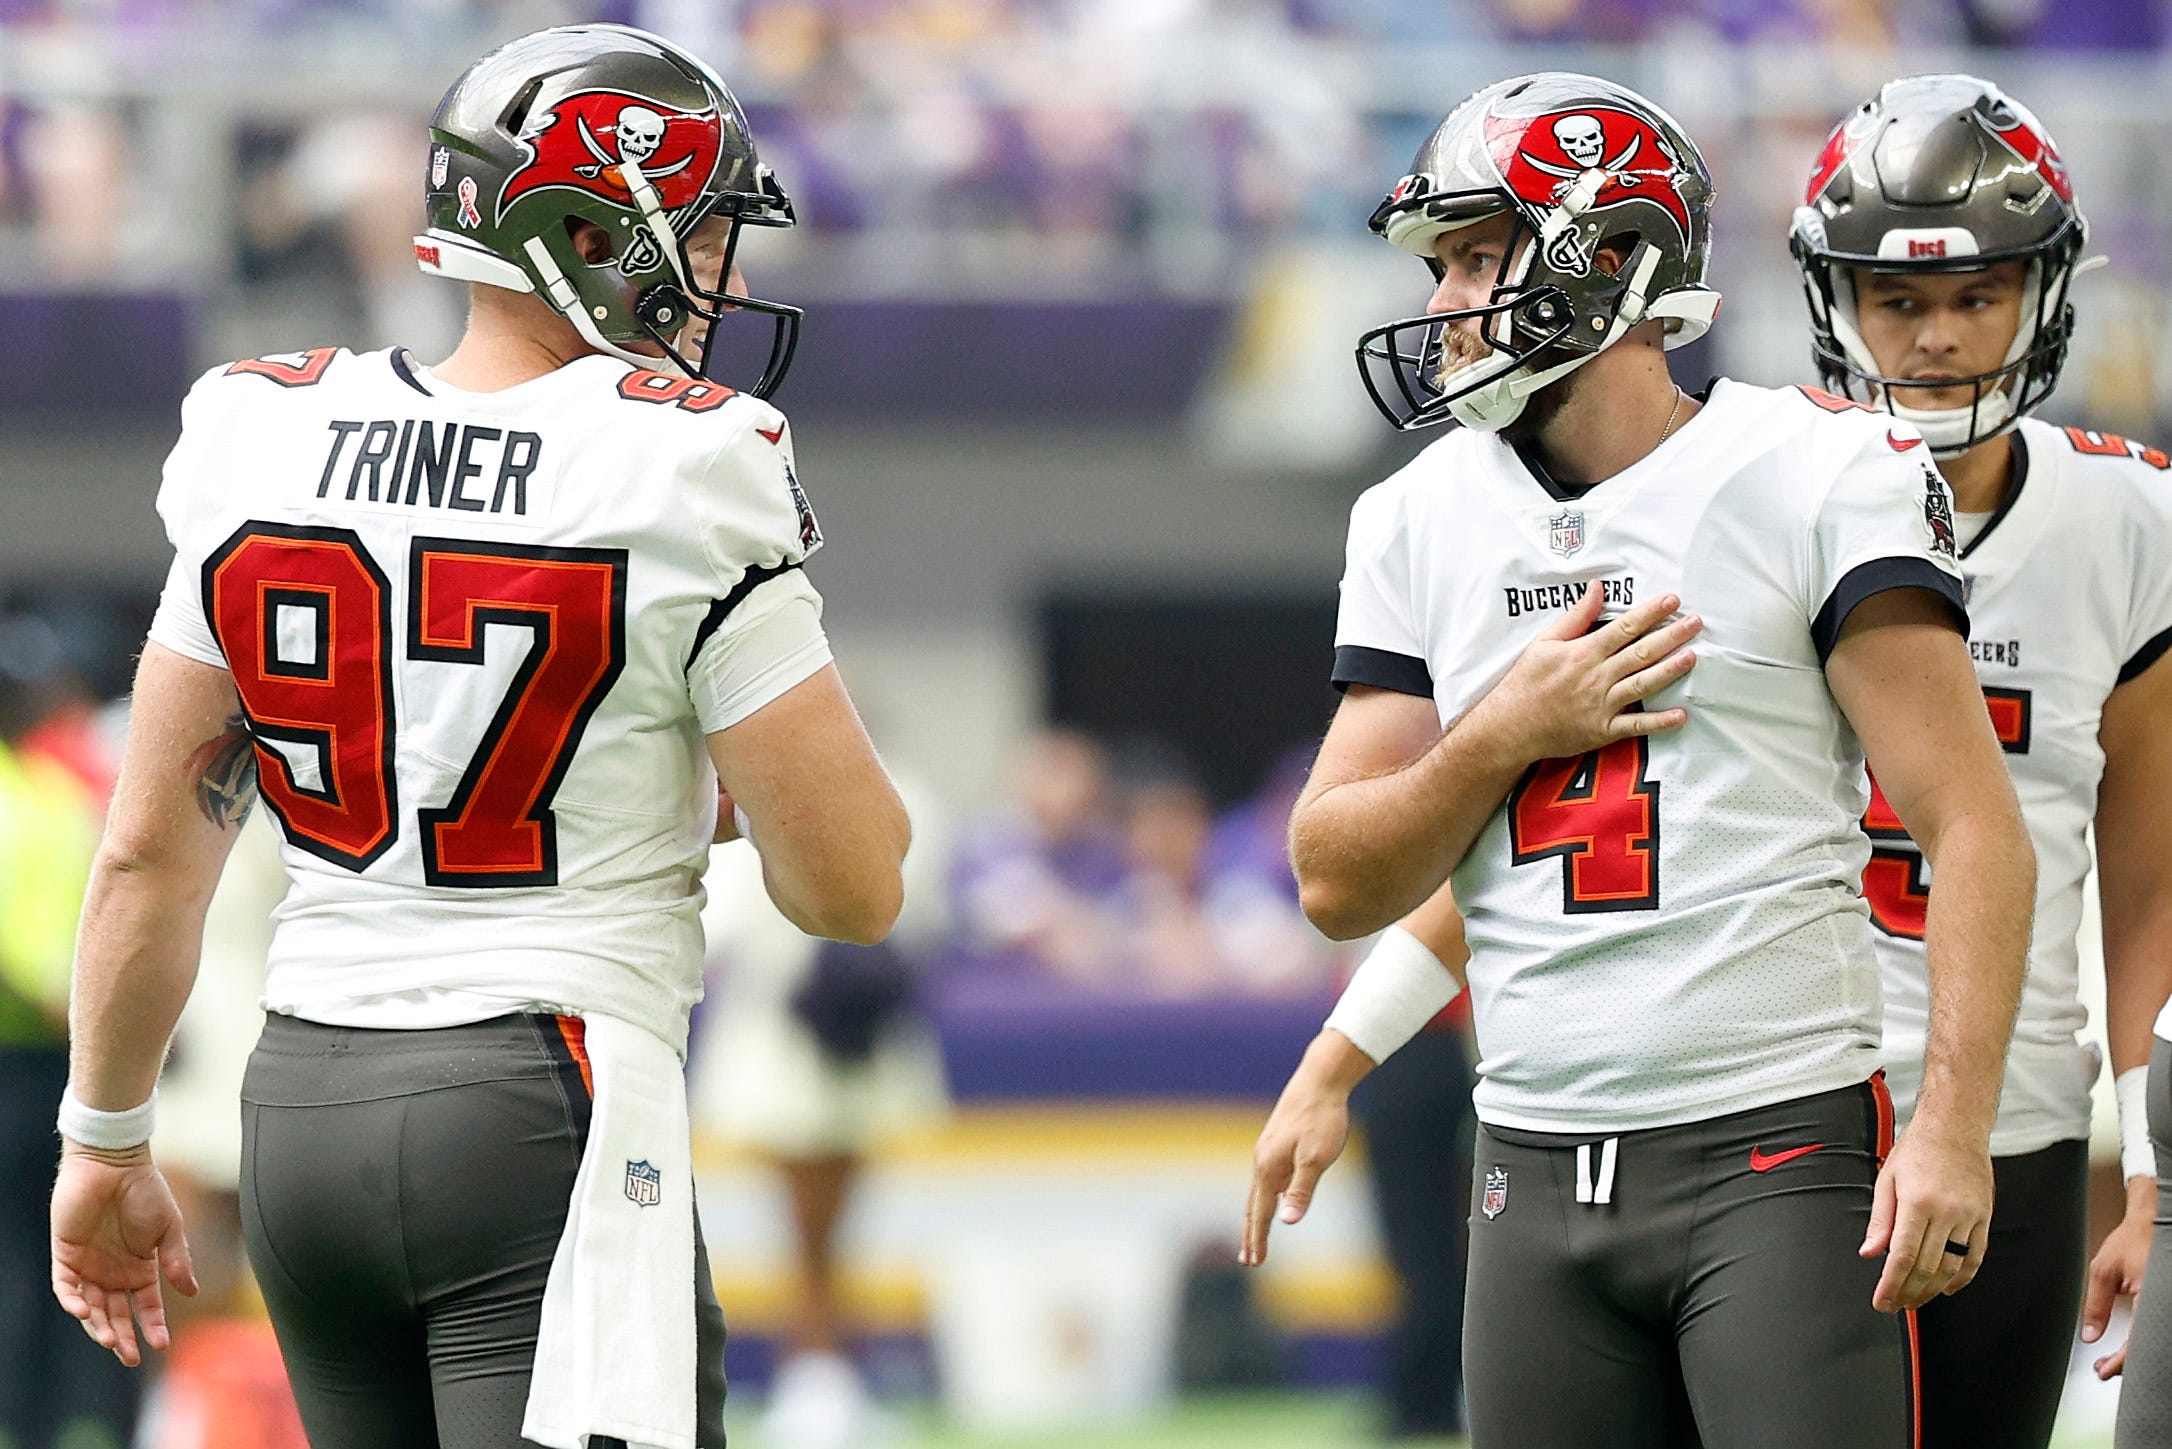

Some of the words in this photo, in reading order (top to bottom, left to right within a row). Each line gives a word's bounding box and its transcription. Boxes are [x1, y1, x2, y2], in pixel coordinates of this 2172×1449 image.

[316, 419, 543, 516] TRINER
[1554, 530, 1580, 549] NFL
[1504, 577, 1634, 617] BUCCANERS
[201, 519, 629, 888] 97
[1508, 619, 1660, 914] 4
[628, 1177, 657, 1203] NFL
